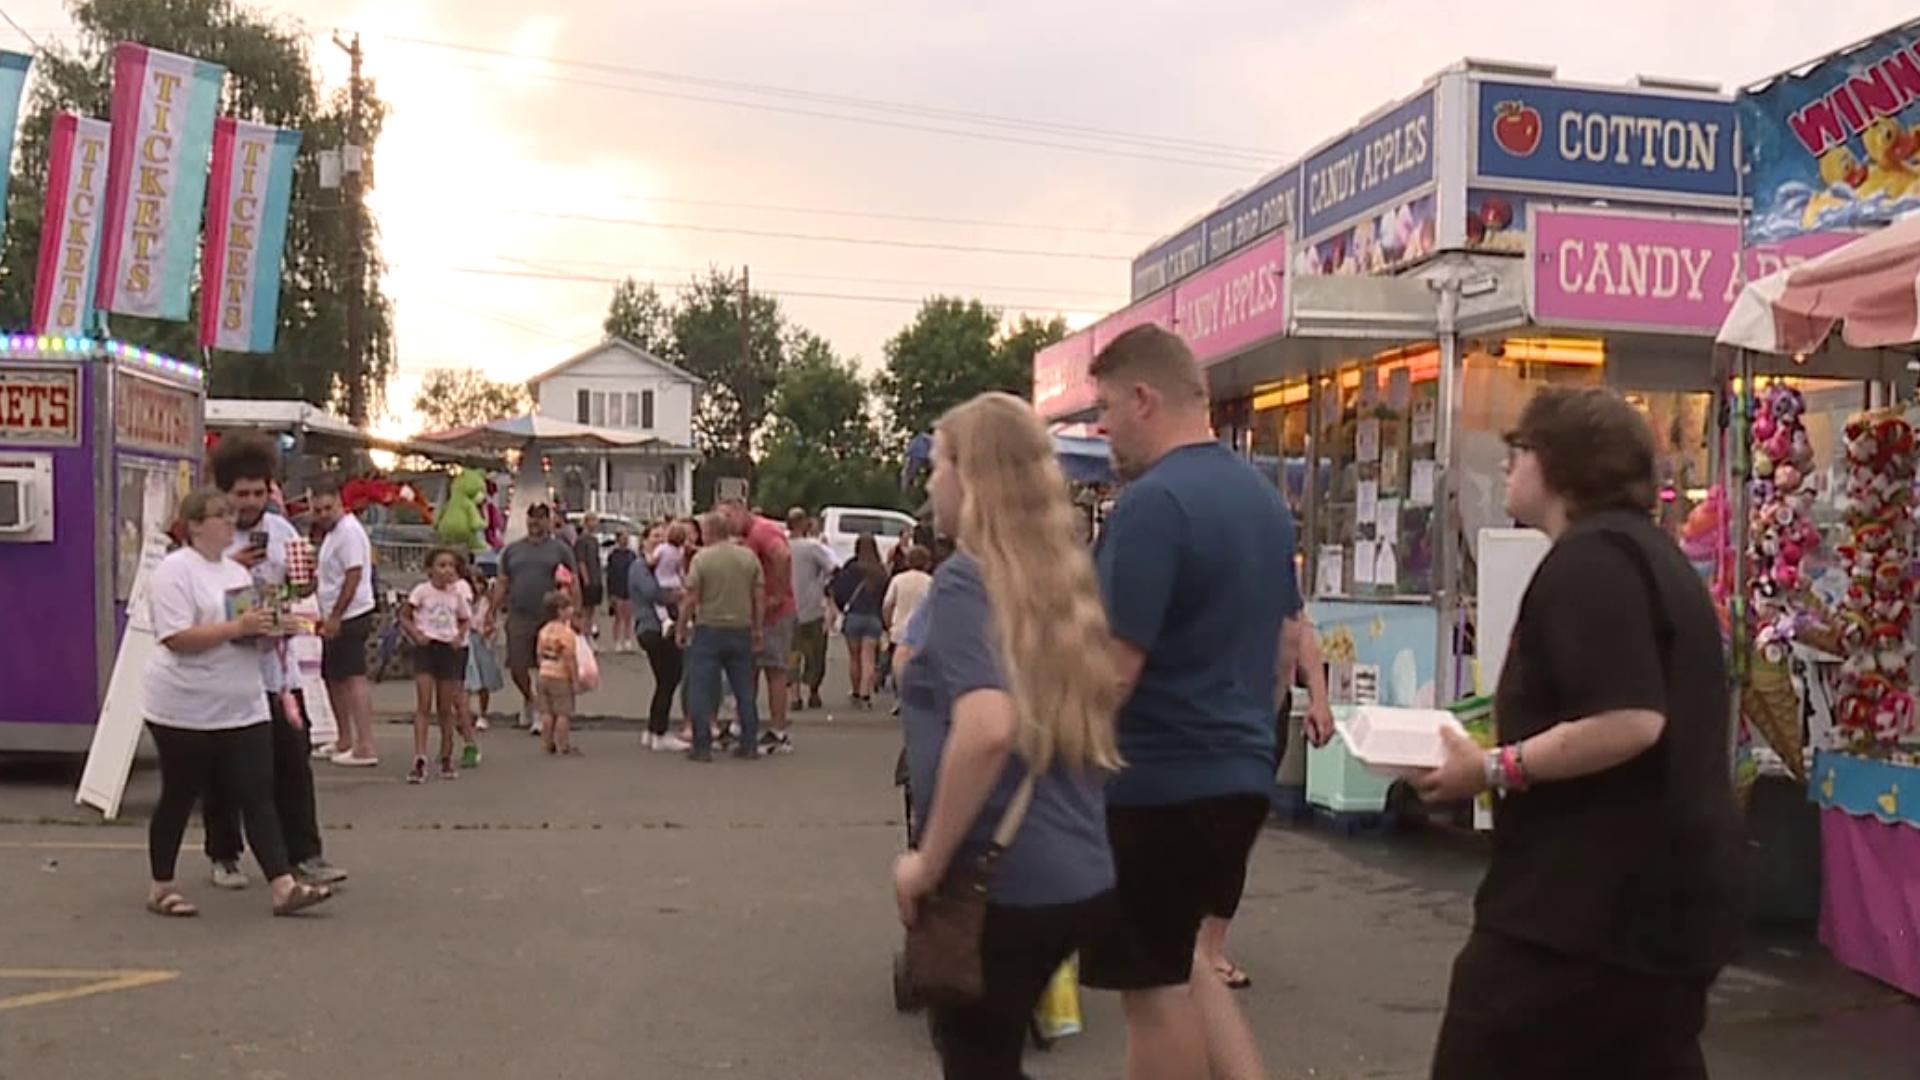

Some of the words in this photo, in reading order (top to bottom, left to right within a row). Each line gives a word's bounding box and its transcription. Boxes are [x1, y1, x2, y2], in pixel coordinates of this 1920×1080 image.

[1309, 154, 1359, 215] CANDY
[1363, 115, 1428, 190] APPLES
[1558, 110, 1719, 171] COTTON
[126, 70, 181, 296] TICKETS
[58, 137, 103, 328] TICKETS
[221, 138, 266, 332] TICKETS
[1558, 239, 1712, 301] CANDY
[1222, 262, 1278, 328] APPLES
[0, 384, 69, 428] ETS
